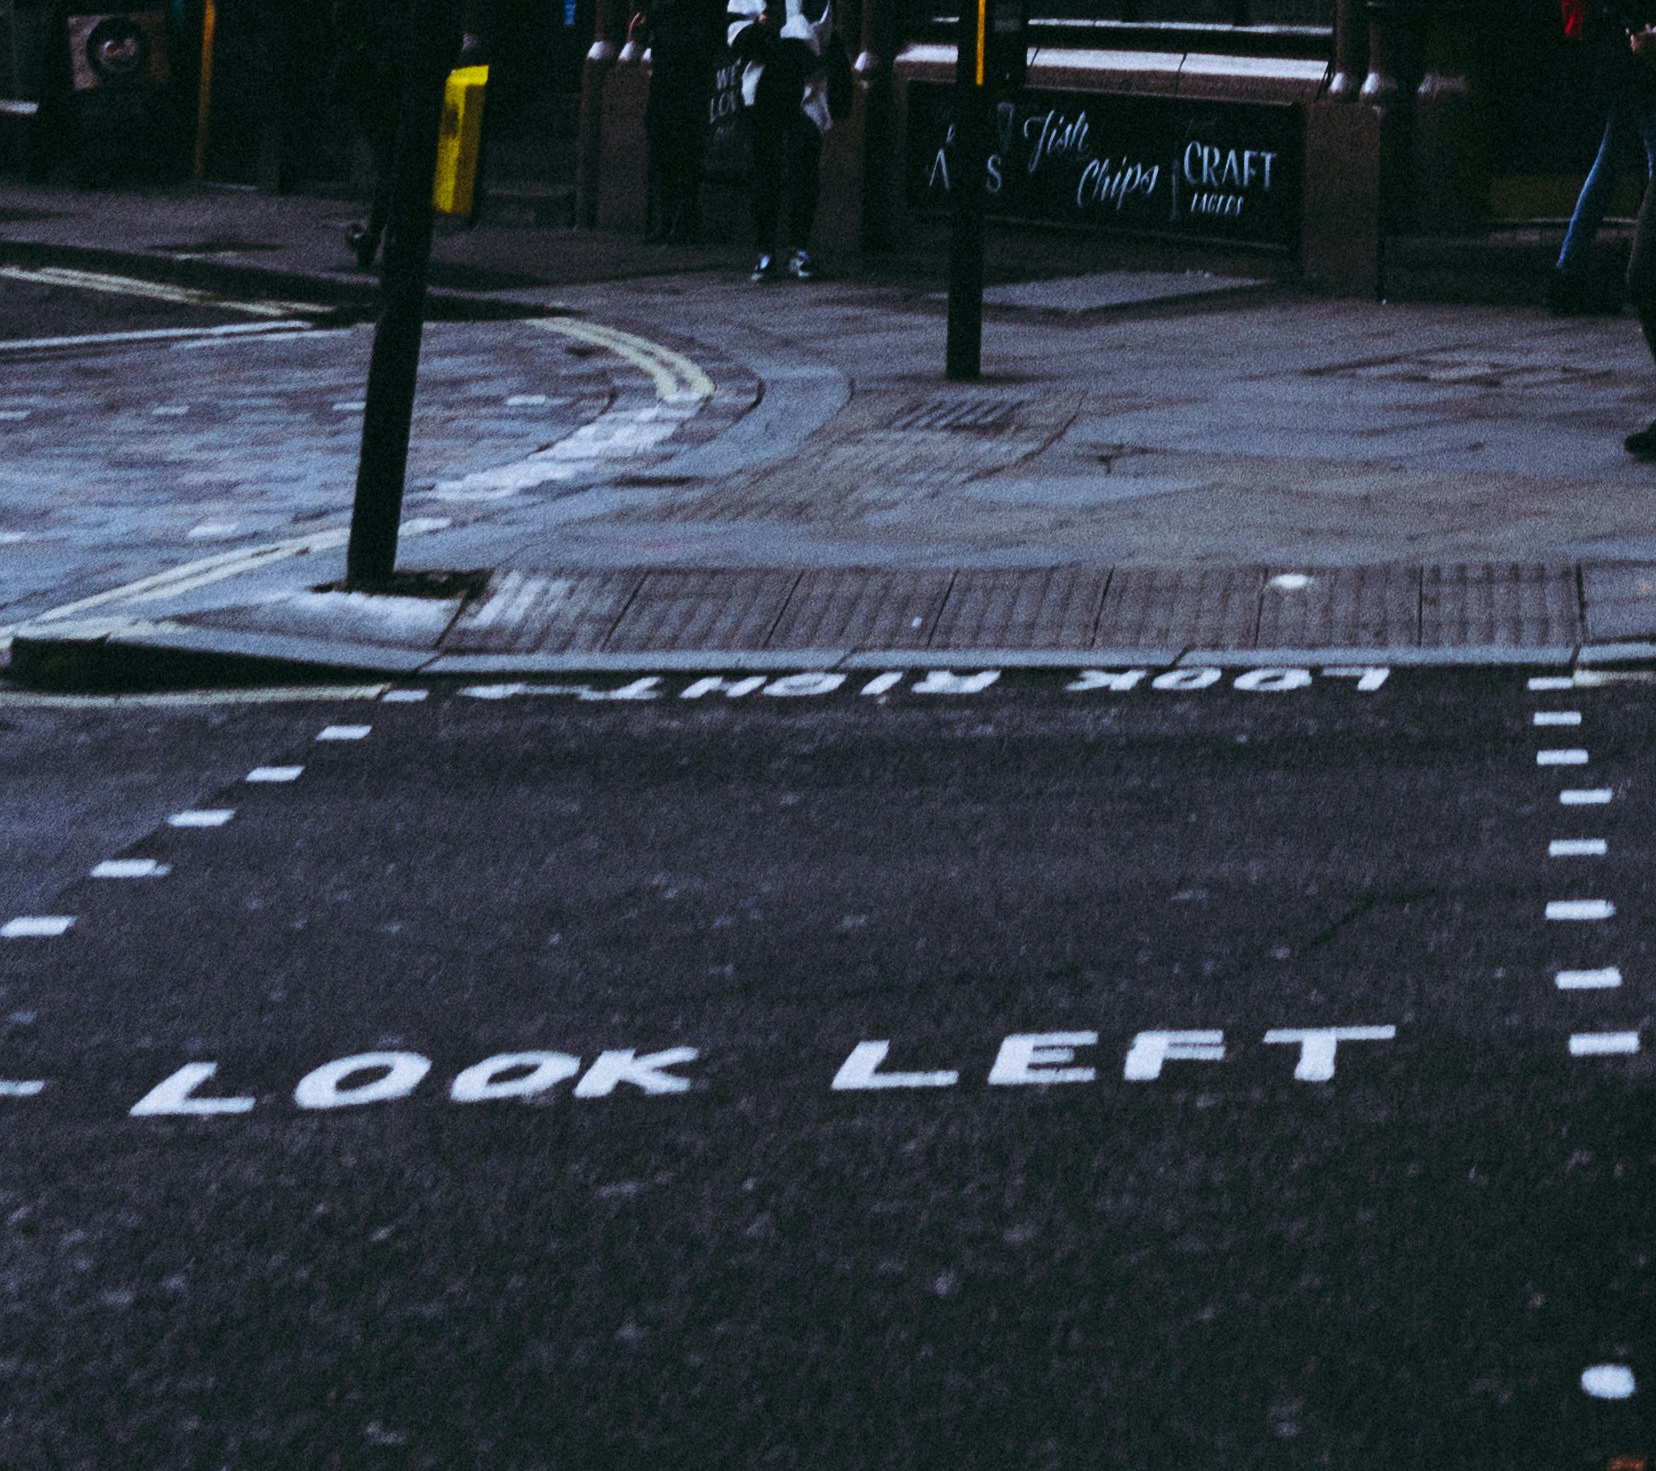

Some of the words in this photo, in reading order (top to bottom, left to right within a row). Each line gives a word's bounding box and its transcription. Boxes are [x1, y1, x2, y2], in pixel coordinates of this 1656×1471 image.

[1077, 155, 1160, 212] Chips
[1183, 139, 1279, 192] CRAFT
[1064, 666, 1391, 691] LOOK
[128, 1045, 699, 1117] LOOK
[830, 1023, 1396, 1093] LEFT
